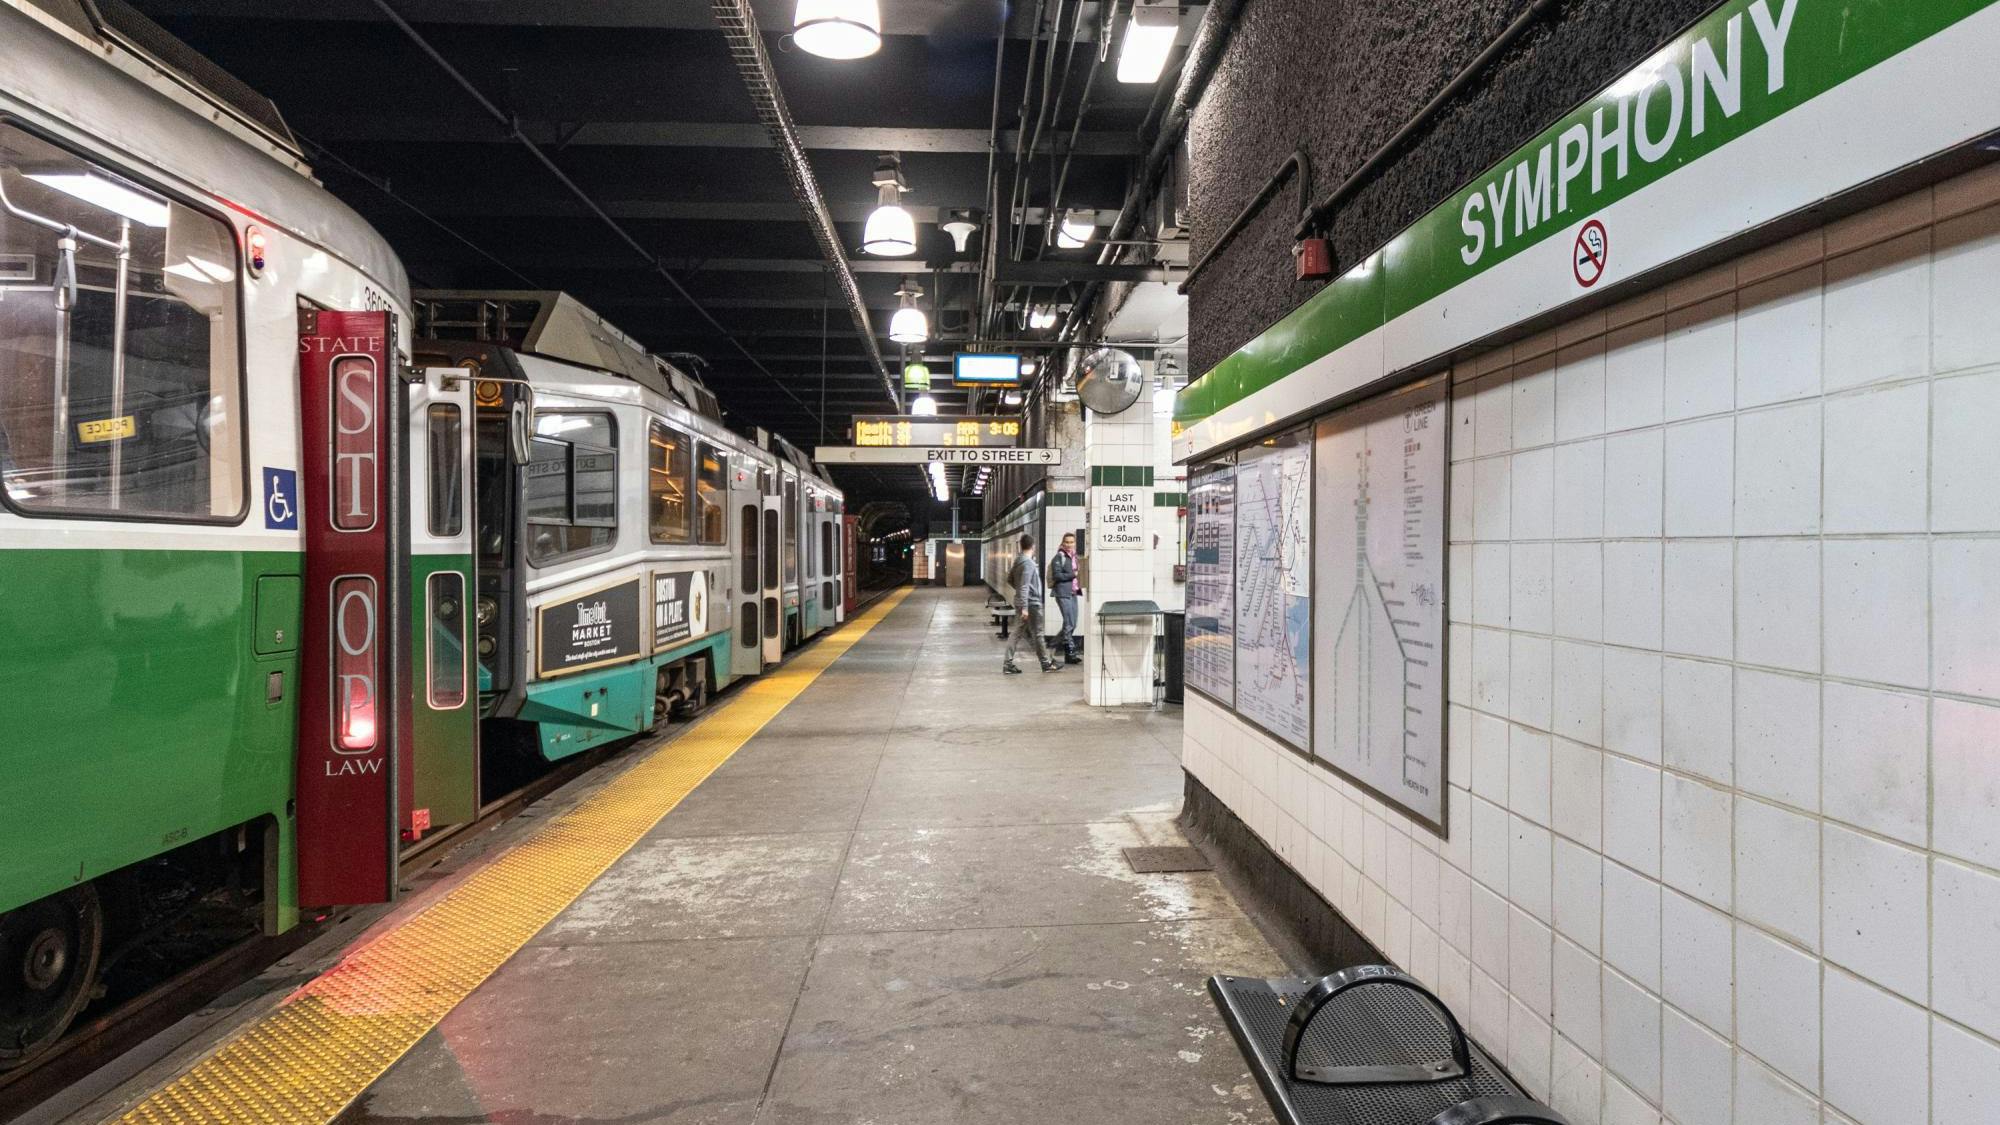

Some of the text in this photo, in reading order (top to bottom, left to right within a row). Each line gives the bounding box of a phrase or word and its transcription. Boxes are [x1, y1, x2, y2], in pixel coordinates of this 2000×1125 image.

[1460, 0, 1798, 266] SYMPHONY
[300, 336, 381, 353] STATE
[856, 421, 892, 435] Heath
[989, 421, 1018, 436] 3:06
[1413, 416, 1429, 432] LINE
[943, 433, 952, 446] 5
[927, 450, 1033, 461] EXIT TO STREET
[1109, 494, 1134, 502] LAST
[1103, 515, 1140, 523] LEAVES
[1102, 534, 1141, 543] 12:50am
[338, 369, 375, 738] STOP
[572, 624, 612, 641] MARKET
[325, 758, 383, 776] LAW
